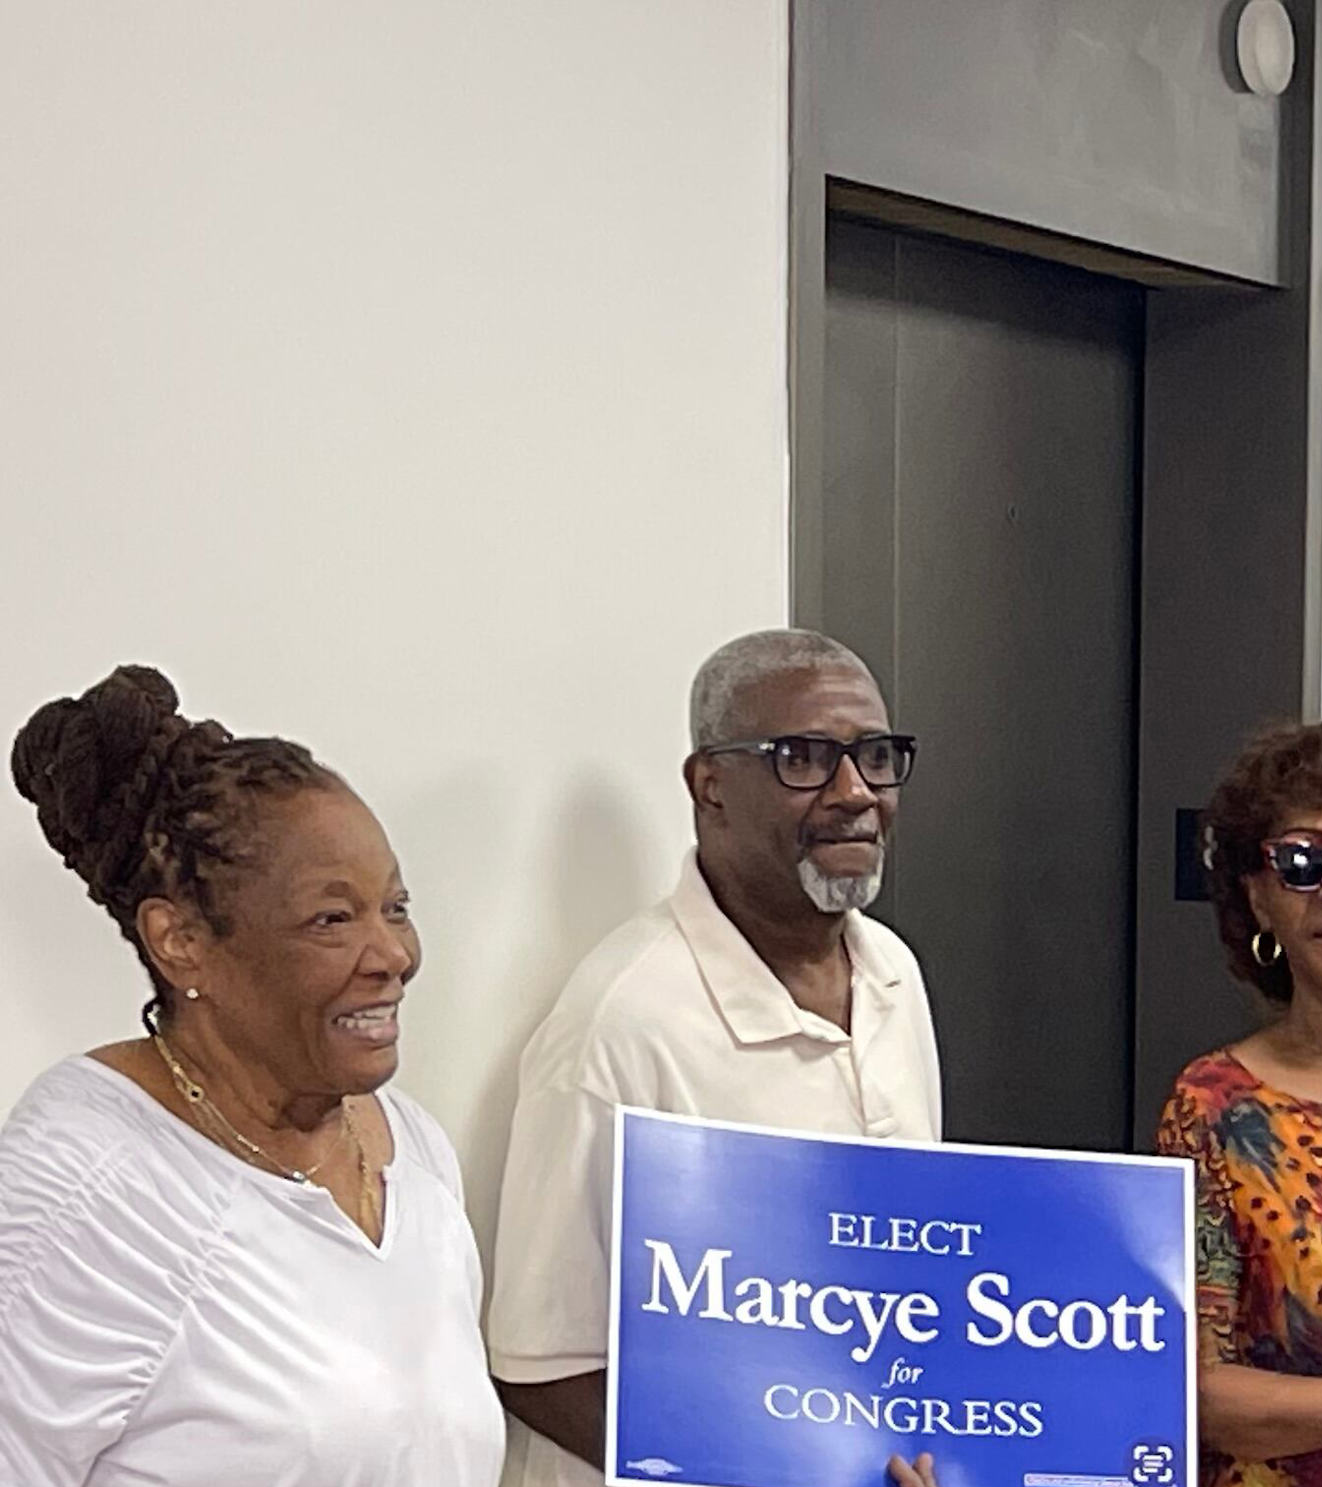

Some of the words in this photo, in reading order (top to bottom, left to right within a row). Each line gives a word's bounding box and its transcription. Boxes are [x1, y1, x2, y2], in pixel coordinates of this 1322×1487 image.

[828, 1212, 982, 1257] ELECT
[641, 1237, 940, 1362] Marcye
[966, 1271, 1166, 1352] Scott
[882, 1357, 925, 1389] for
[764, 1383, 1044, 1437] CONGRESS
